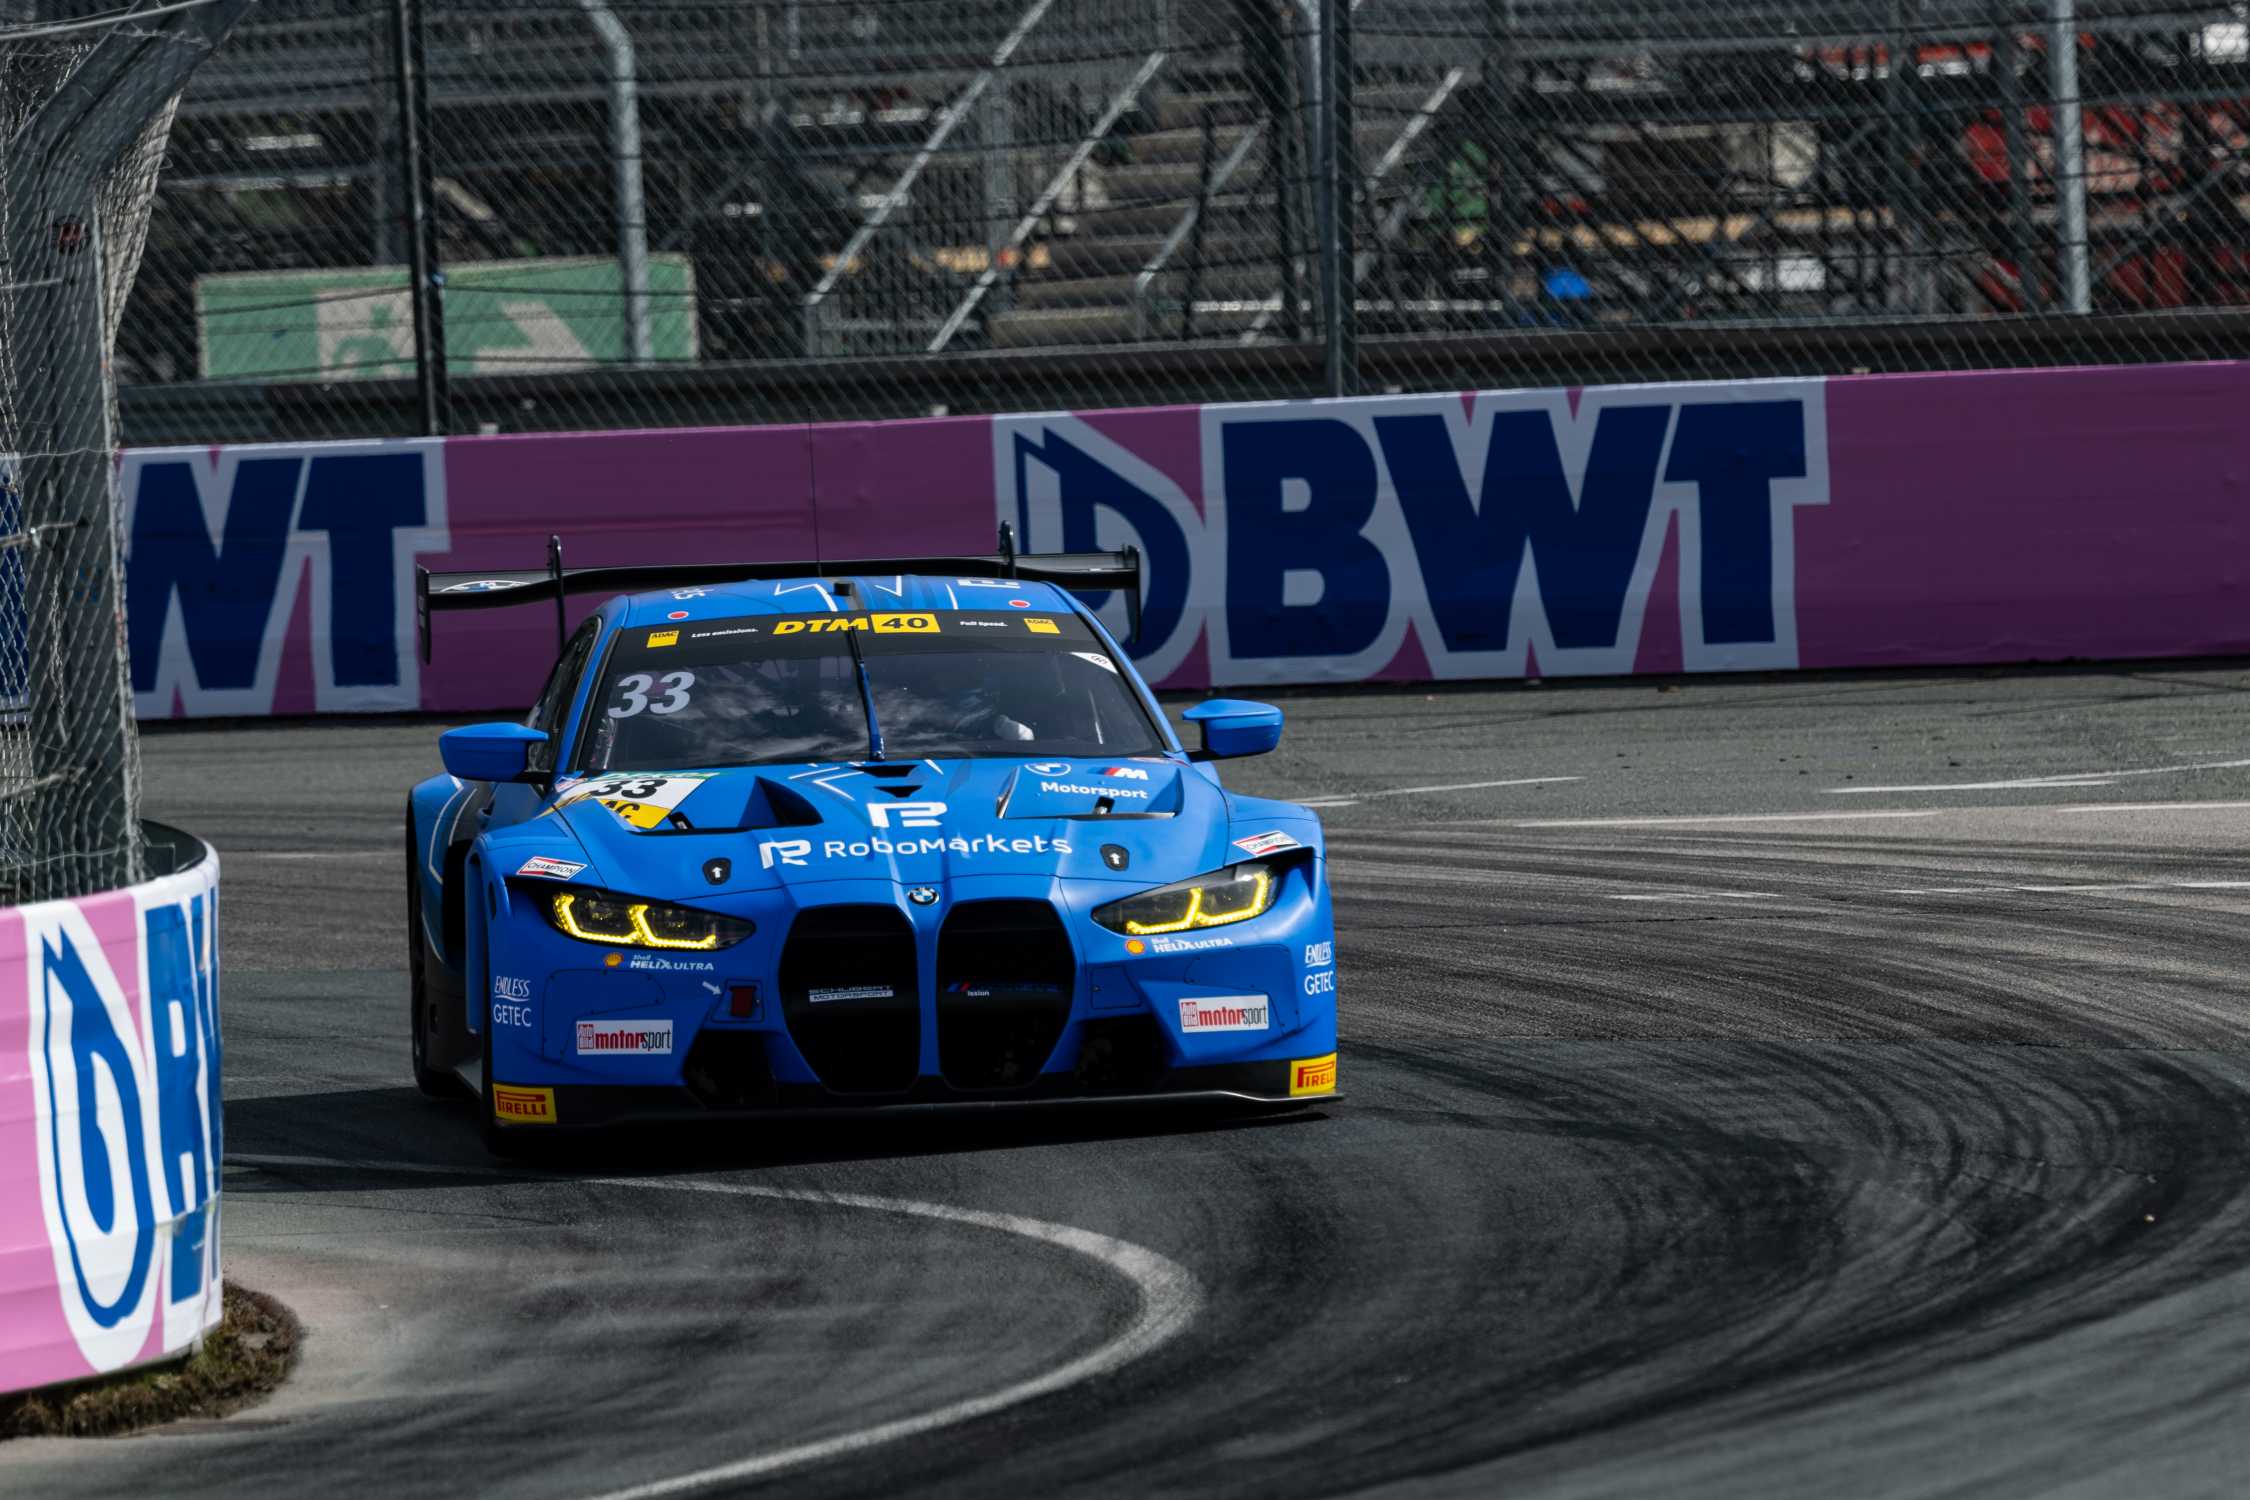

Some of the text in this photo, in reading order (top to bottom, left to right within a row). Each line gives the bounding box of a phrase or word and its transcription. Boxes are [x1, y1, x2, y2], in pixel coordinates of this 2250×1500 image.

[773, 617, 928, 635] DTM 40
[608, 671, 696, 718] 33
[589, 779, 668, 799] 33
[1040, 781, 1149, 799] Motorsport
[823, 834, 1073, 859] RoboMarkets
[527, 862, 576, 874] CHAMPION
[1305, 941, 1332, 963] ENDLESS
[630, 959, 714, 970] HELIX ULTRA
[494, 975, 531, 998] ENDLESS
[1304, 971, 1334, 995] GETEC
[493, 1004, 532, 1027] GETEC
[1199, 1005, 1267, 1028] motorsport
[595, 1028, 671, 1051] motorsport
[496, 1090, 547, 1115] PIRELLI
